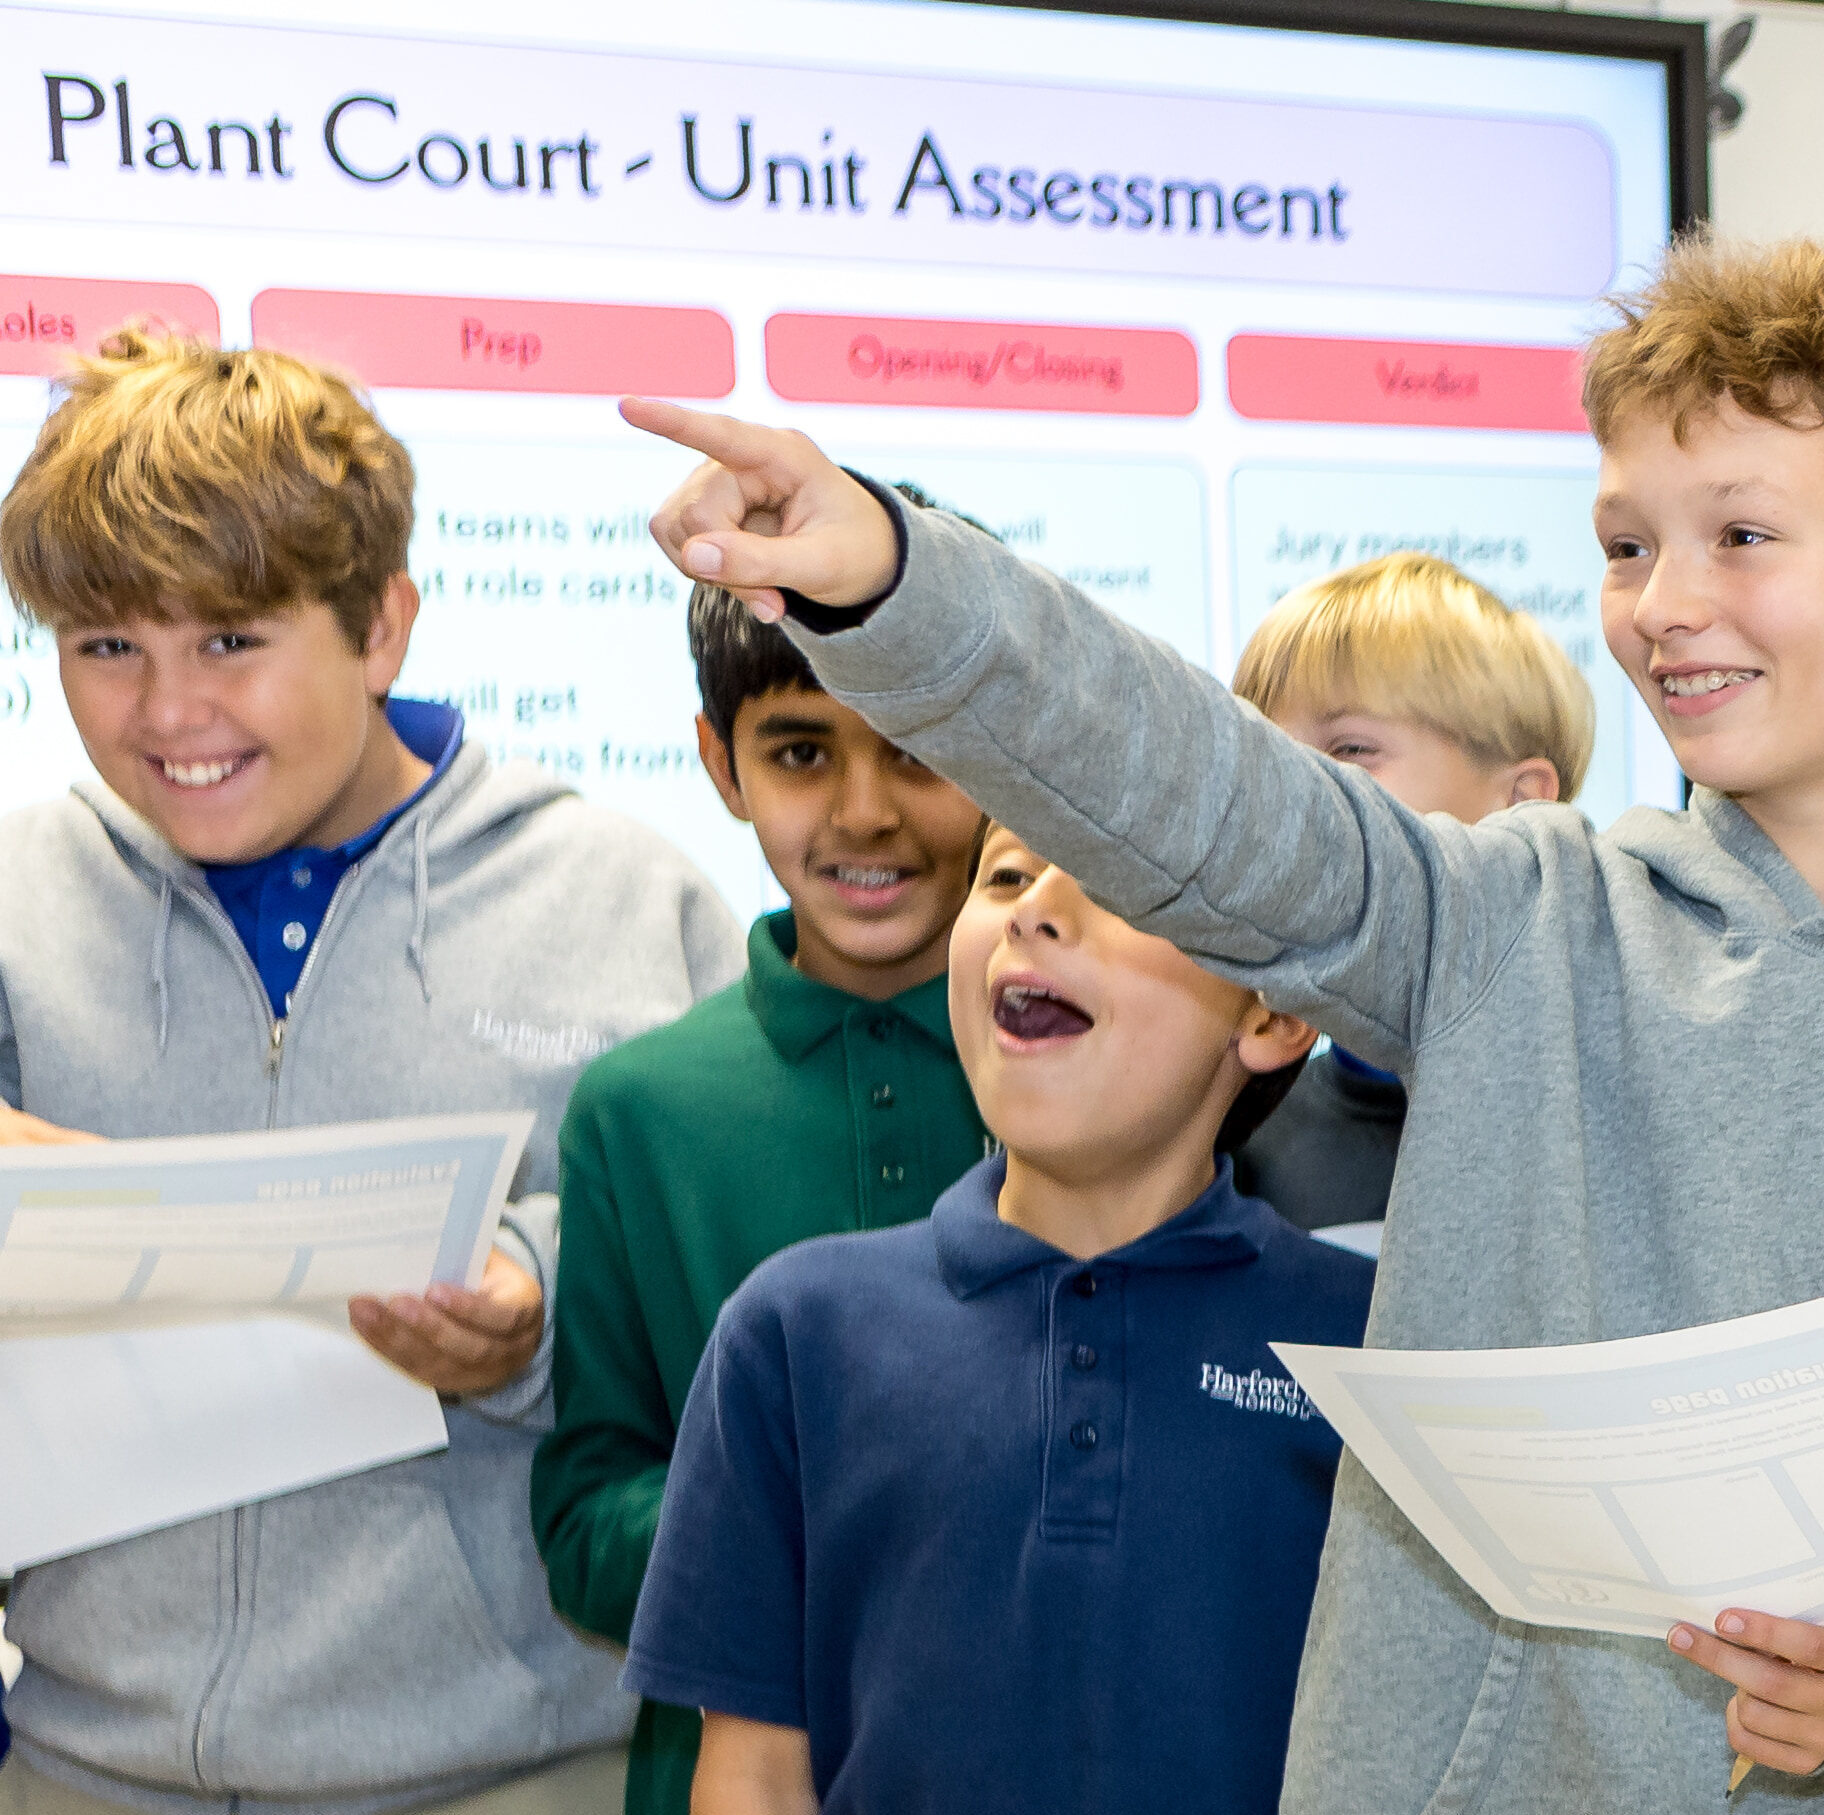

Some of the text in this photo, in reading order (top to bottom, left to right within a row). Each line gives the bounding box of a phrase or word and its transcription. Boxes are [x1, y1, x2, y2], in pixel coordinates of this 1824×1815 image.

[43, 72, 1348, 241] Plant Court - Unit Assessment
[0, 300, 77, 343] oles
[461, 317, 542, 370] Prep
[848, 333, 1126, 394] Opening/Closing
[1267, 526, 1347, 568] Jury
[561, 568, 678, 603] cards
[515, 685, 577, 724] get
[1200, 1362, 1300, 1402] Harford
